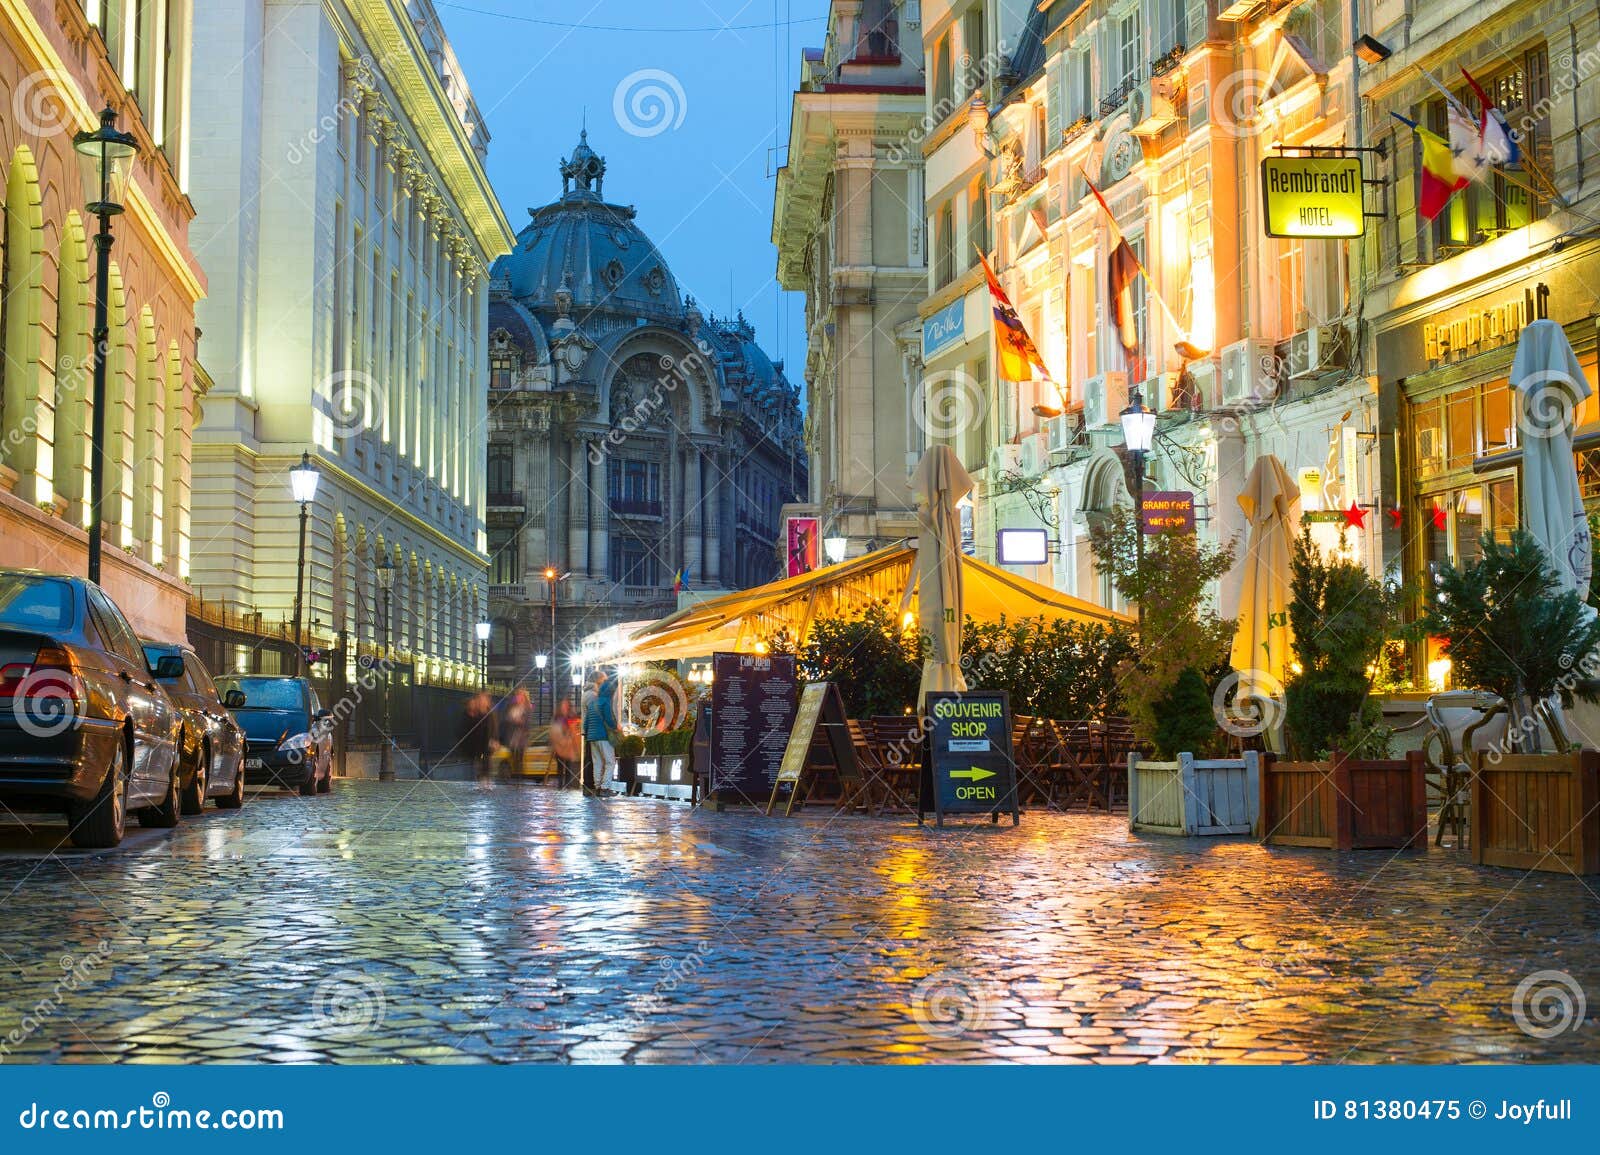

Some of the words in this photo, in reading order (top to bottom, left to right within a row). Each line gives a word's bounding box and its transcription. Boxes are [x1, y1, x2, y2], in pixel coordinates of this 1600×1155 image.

[1299, 207, 1333, 226] HOTEL
[1142, 500, 1170, 510] GRAND
[935, 703, 1002, 718] SOUVENIR
[951, 722, 987, 737] SHOP
[956, 786, 995, 799] OPEN
